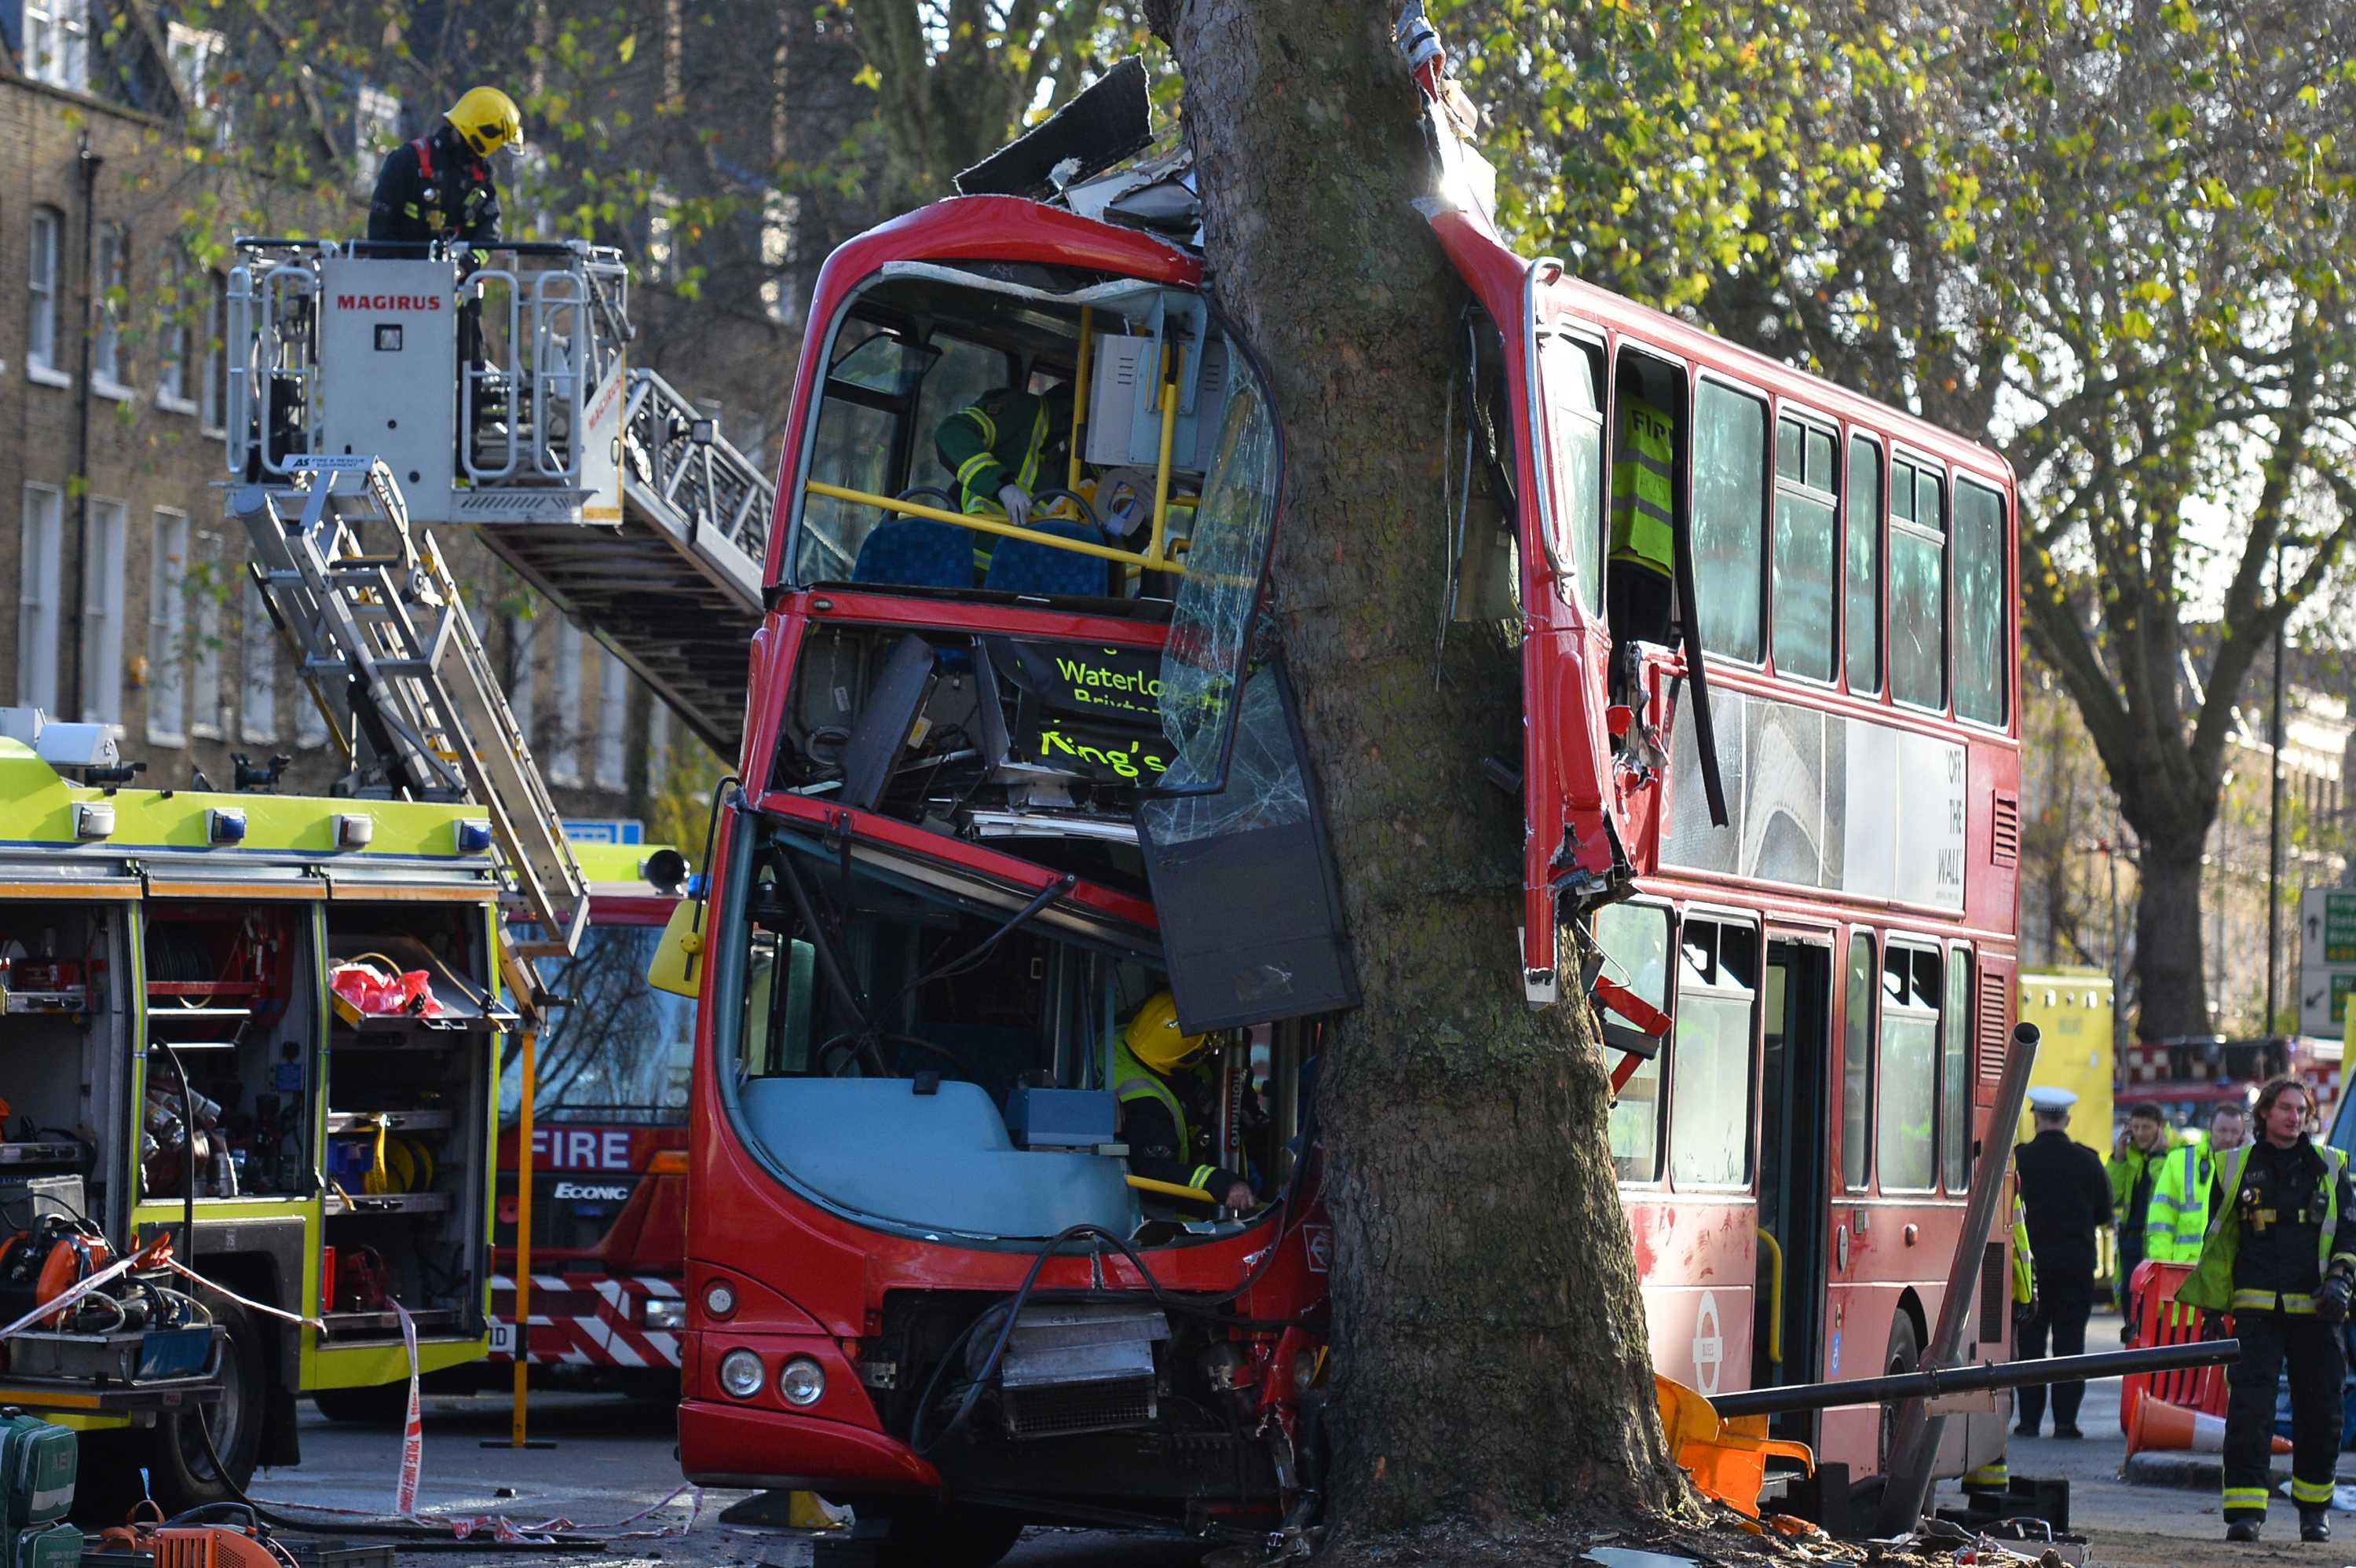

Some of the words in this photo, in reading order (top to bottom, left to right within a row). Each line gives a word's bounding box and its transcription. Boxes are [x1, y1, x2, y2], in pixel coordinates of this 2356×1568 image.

[337, 294, 441, 310] MAGIRUS
[1632, 409, 1672, 448] FIR
[1948, 799, 1962, 835] THE
[404, 1440, 420, 1464] POLICE
